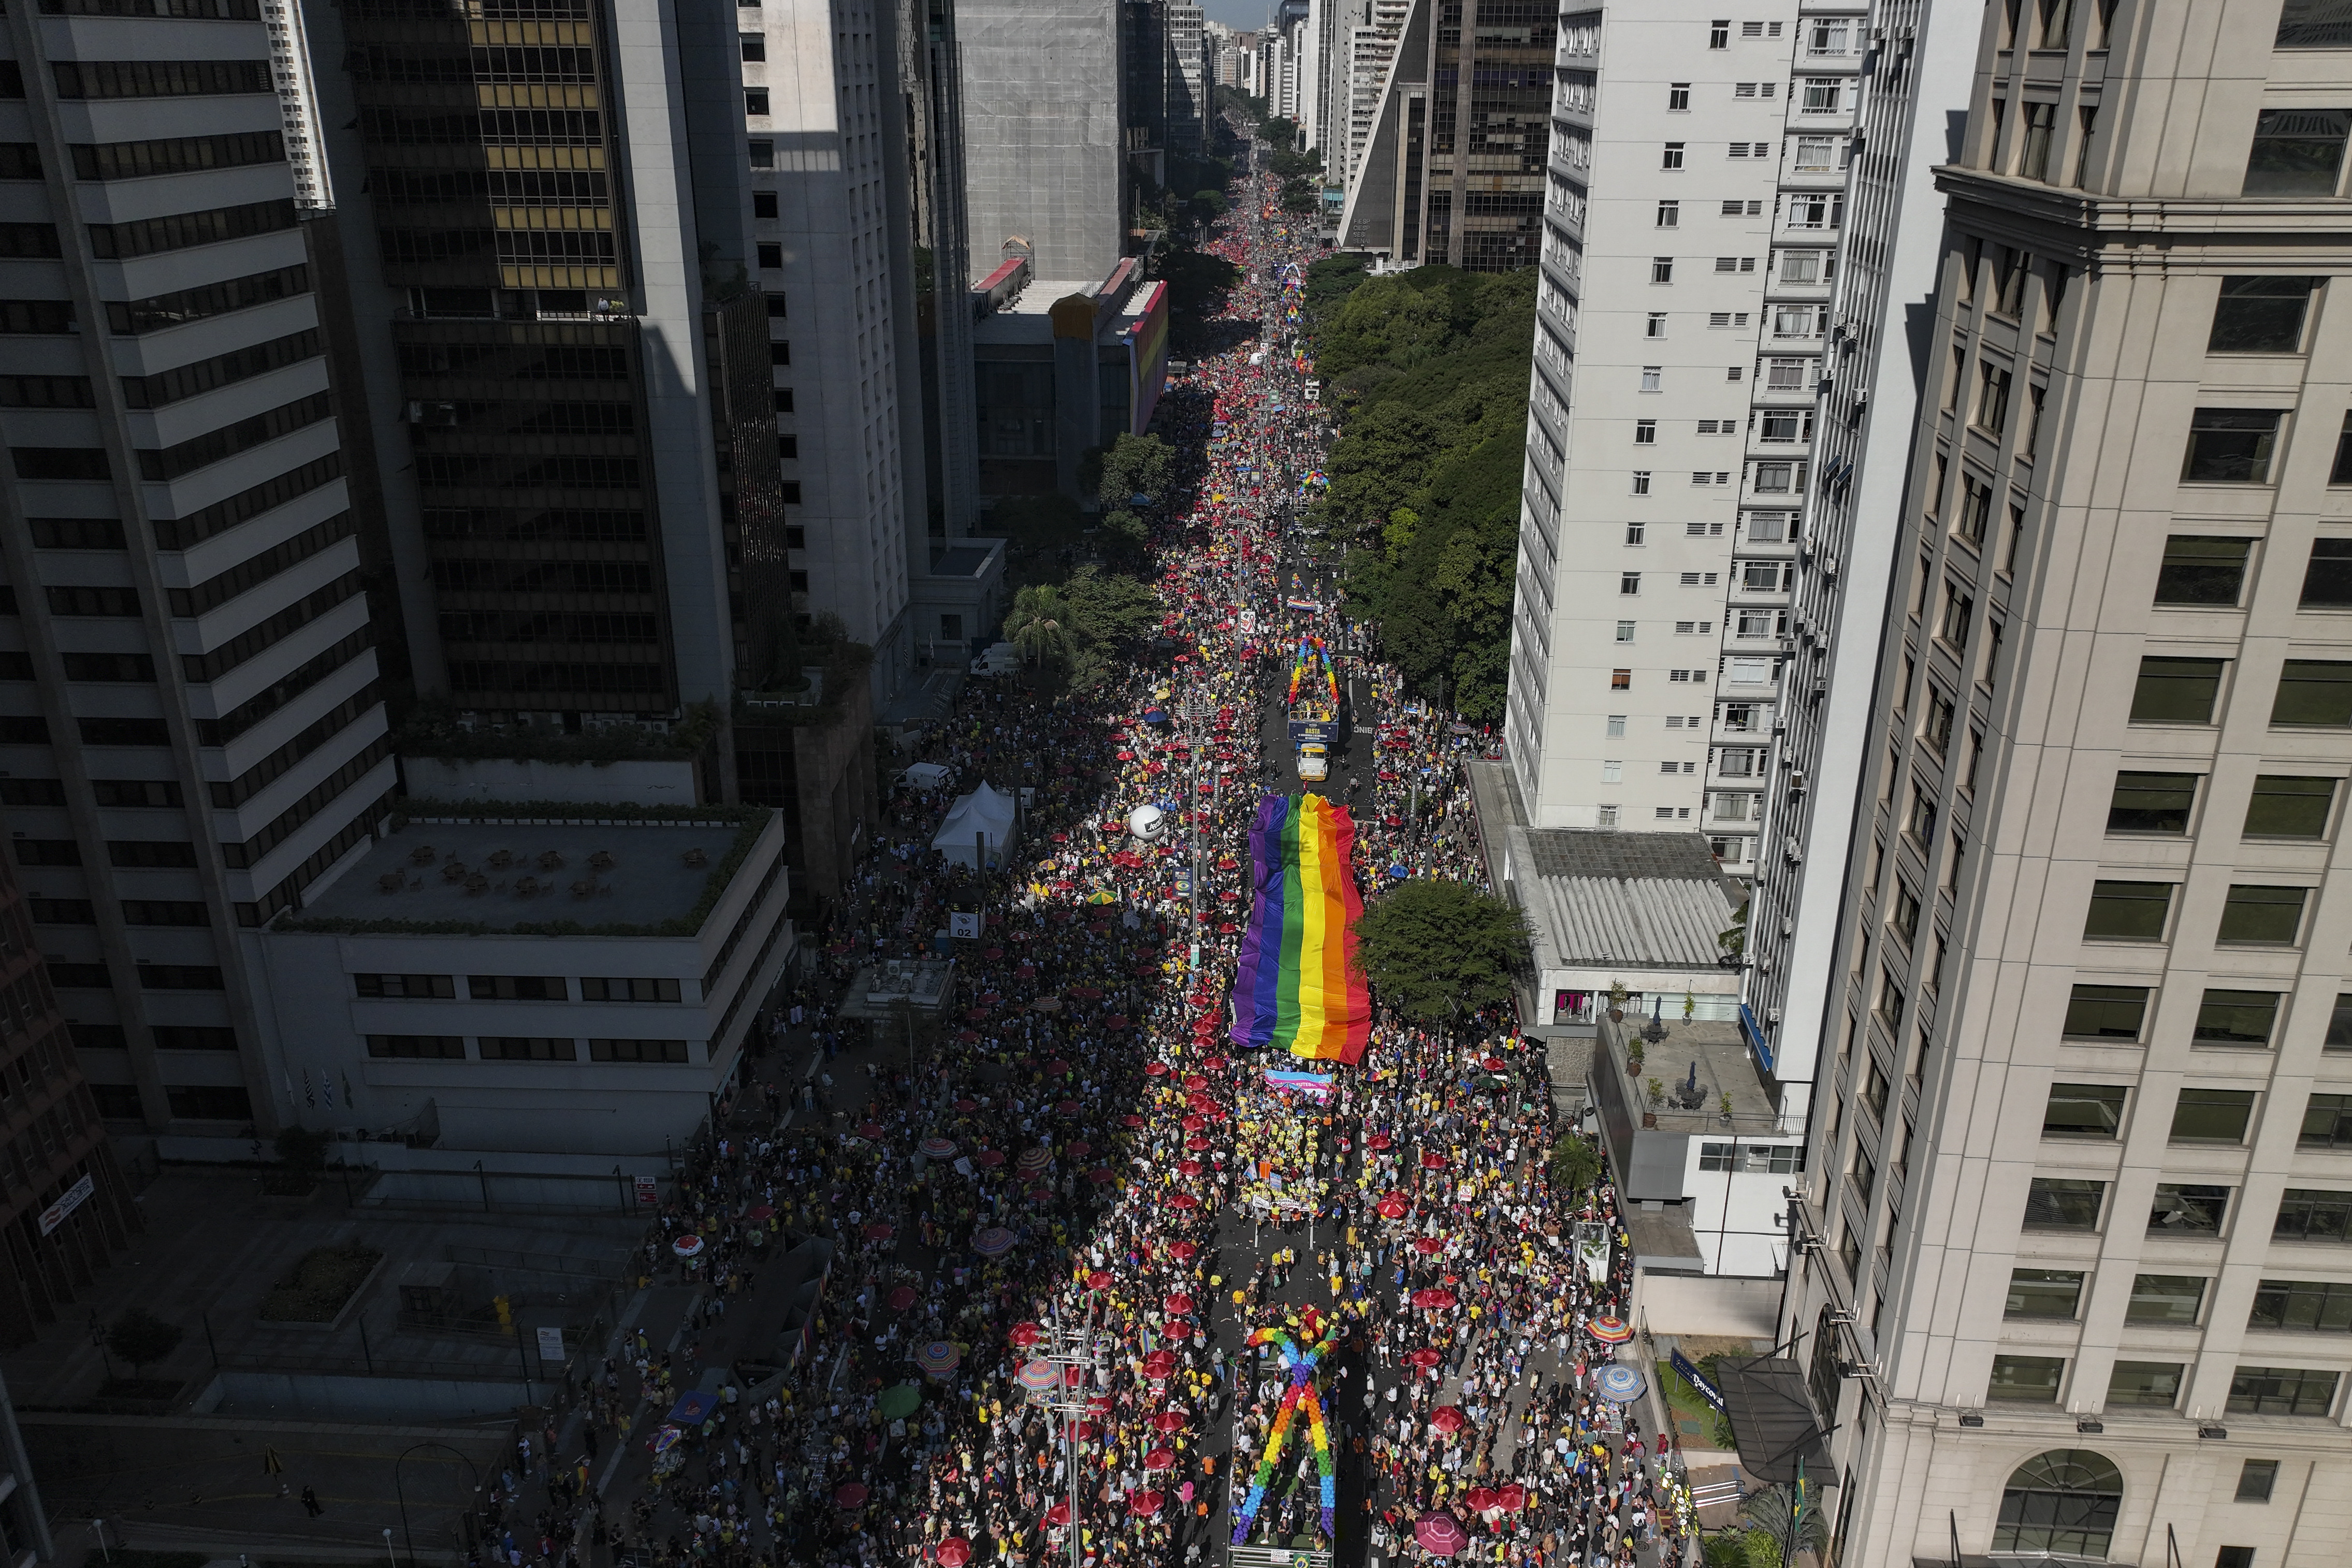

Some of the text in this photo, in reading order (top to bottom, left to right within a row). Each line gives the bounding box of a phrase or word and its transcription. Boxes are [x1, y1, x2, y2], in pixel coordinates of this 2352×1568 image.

[1353, 724, 1373, 734] ÔNIB
[957, 928, 971, 937] 02
[1692, 1373, 1723, 1407] Daycoval
